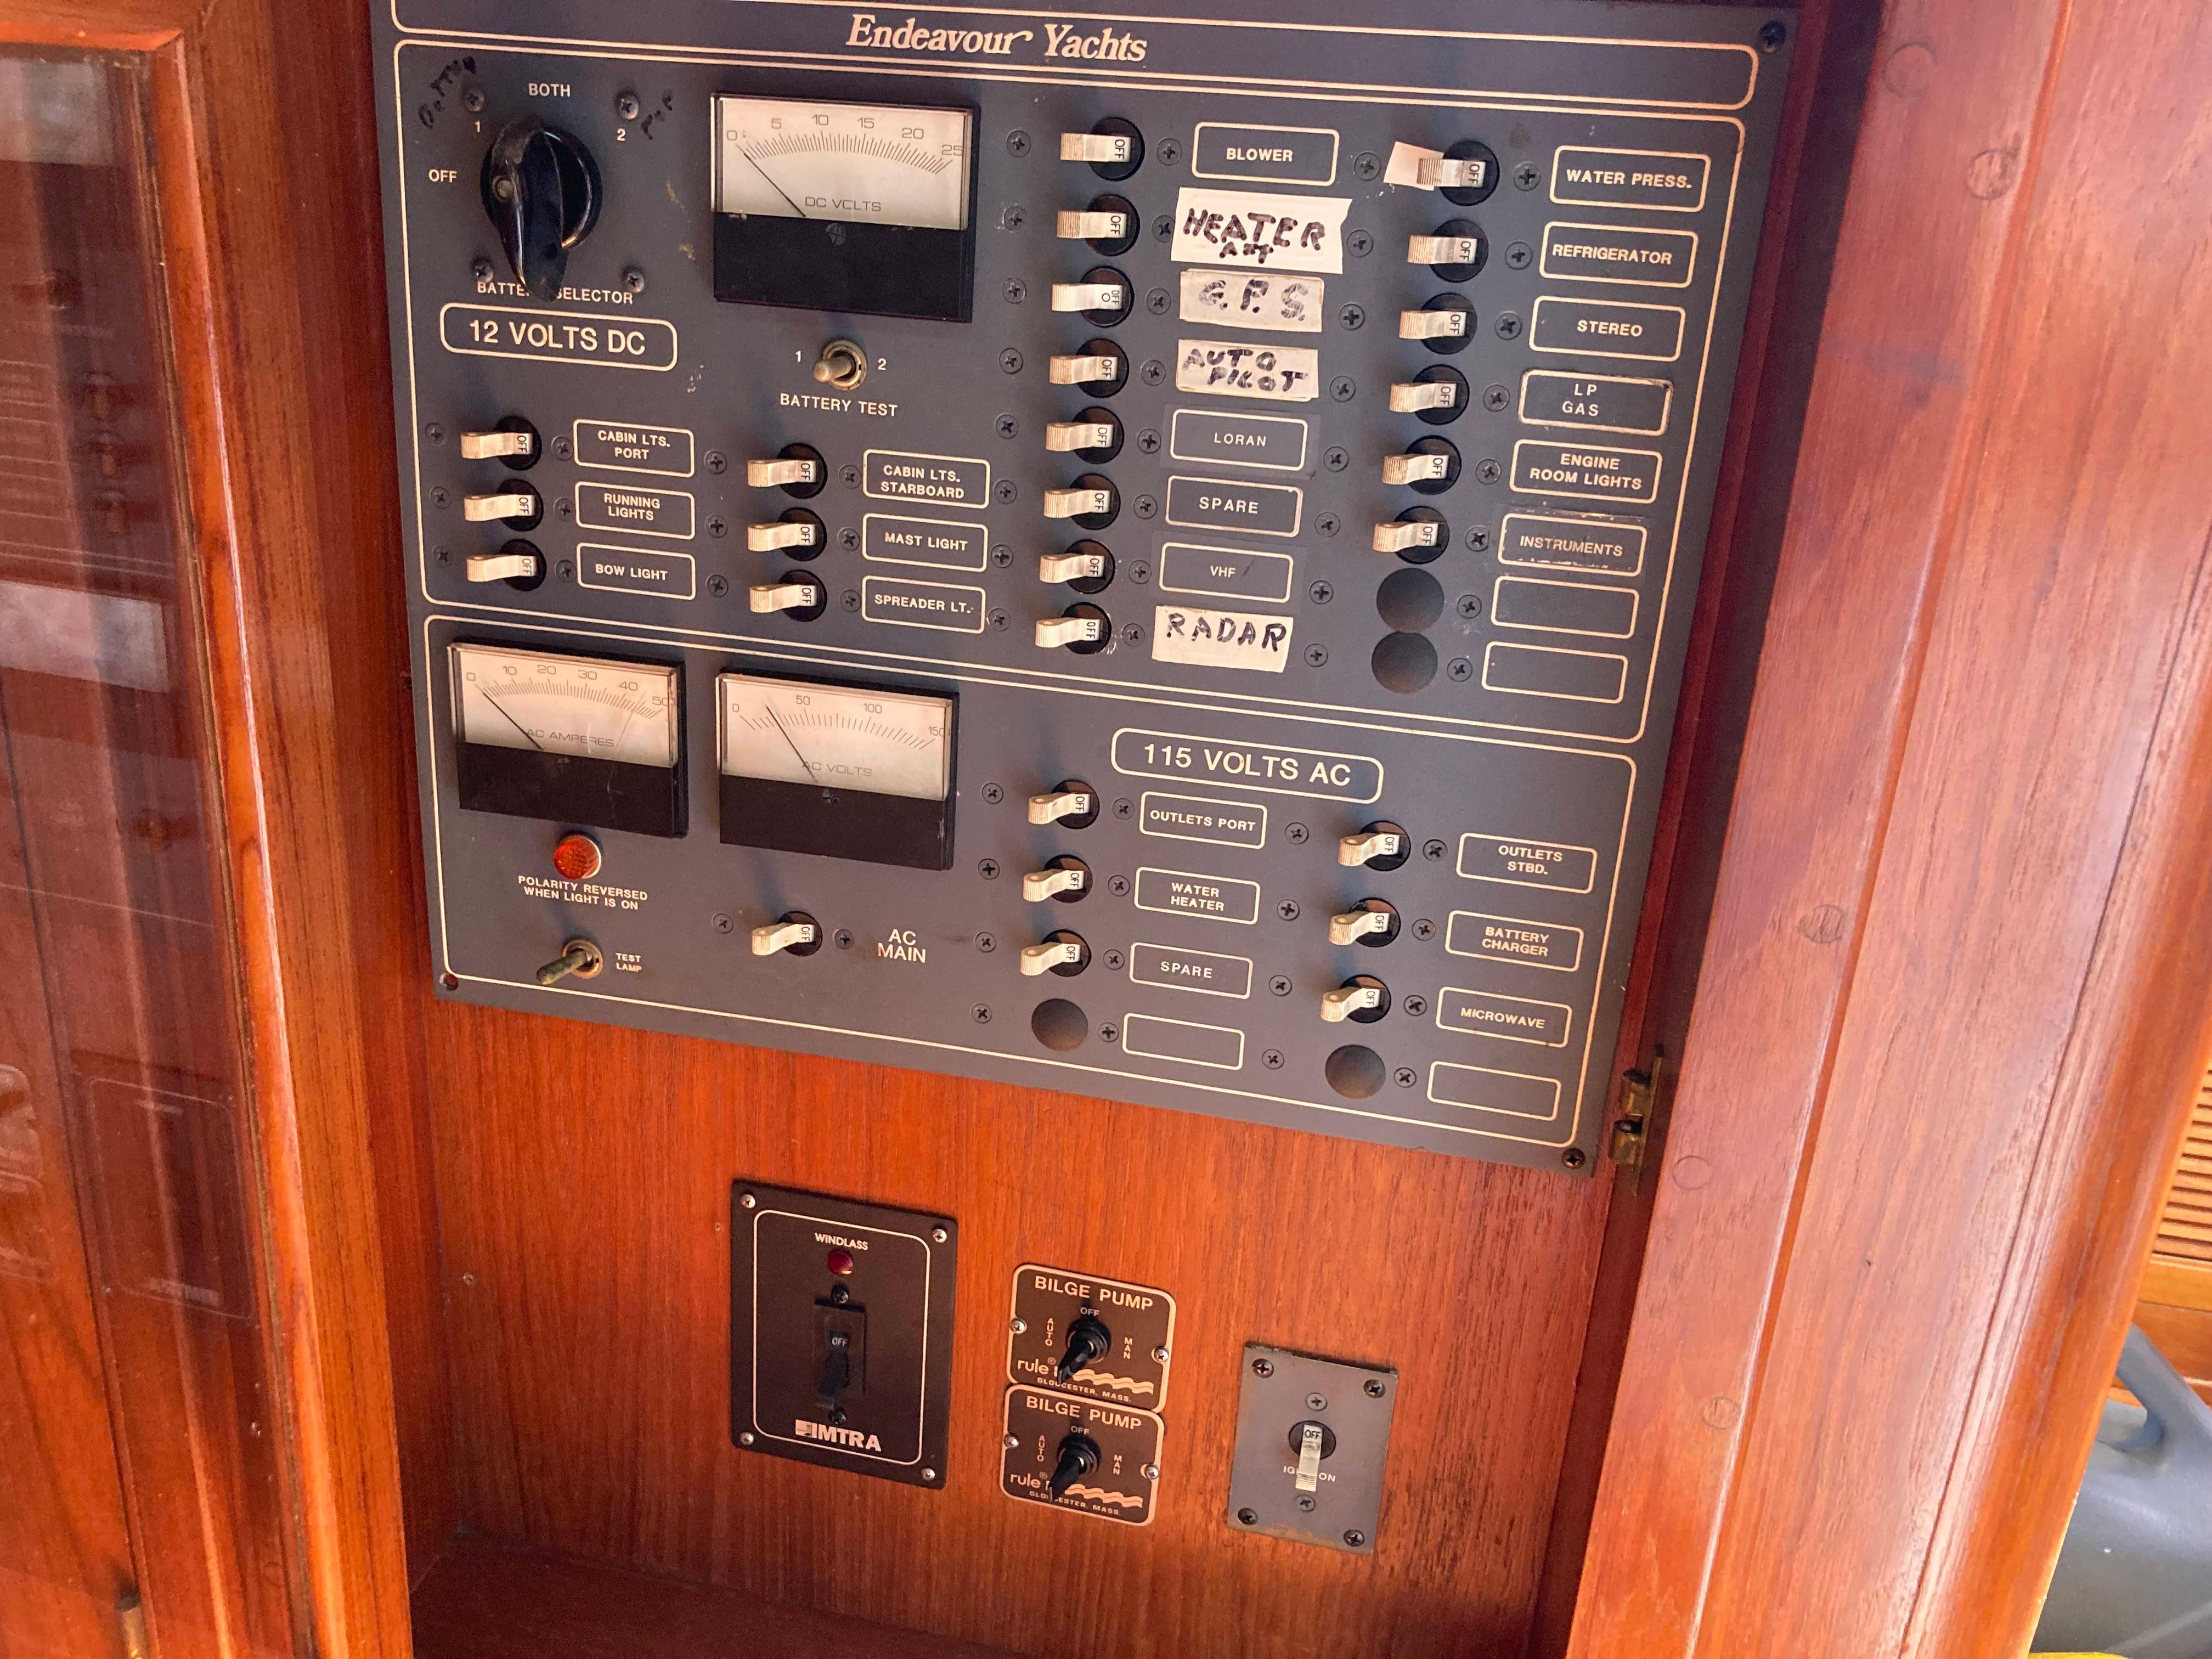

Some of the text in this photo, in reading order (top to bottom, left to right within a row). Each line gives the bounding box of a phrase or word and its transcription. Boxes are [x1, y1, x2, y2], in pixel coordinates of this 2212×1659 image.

[845, 13, 1147, 62] Endeavour Yachts
[528, 83, 571, 97] BOTH
[475, 121, 481, 133] 1
[771, 119, 782, 129] 5
[812, 115, 829, 126] 10
[857, 118, 874, 129] 15
[617, 129, 625, 141] 2
[726, 130, 737, 142] 0
[901, 128, 924, 139] 20
[942, 145, 963, 156] 25
[1114, 138, 1125, 160] OFF
[1226, 148, 1293, 162] BLOWER
[428, 169, 457, 183] OFF
[1469, 163, 1480, 185] OFF
[1566, 169, 1692, 189] WATER PRESS.
[805, 196, 826, 208] DC
[1110, 215, 1121, 236] OFF
[1183, 207, 1326, 251] HEATER
[1460, 240, 1472, 262] OFF
[1552, 244, 1672, 265] REFRIGERATOR
[477, 281, 529, 297] BATTE
[1111, 290, 1120, 307] OFF
[1450, 314, 1461, 335] OFF
[1577, 320, 1643, 337] STEREO
[470, 319, 646, 356] 12 VOLTS DC
[795, 351, 802, 362] 1
[878, 358, 887, 370] 2
[1182, 348, 1277, 372] AUTO
[1101, 359, 1112, 379] OFF
[1440, 386, 1451, 406] OFF
[780, 393, 898, 417] BATTERY TEST
[1562, 400, 1599, 416] GAS
[517, 435, 527, 453] OFF
[598, 430, 671, 448] CABIN LTS.
[1097, 427, 1108, 447] OFF
[1214, 432, 1267, 447] LORAN
[614, 447, 649, 460] PORT
[1560, 453, 1621, 471] ENGINE
[800, 463, 811, 481] OFF
[883, 465, 961, 483] CABIN LTS.
[1432, 458, 1443, 478] OFF
[1530, 468, 1641, 489] ROOM LIGHTS
[881, 482, 964, 499] STARBOARD
[518, 497, 529, 515] OFF
[604, 493, 661, 510] RUNNING
[1094, 493, 1105, 512] OFF
[1199, 496, 1259, 514] SPARE
[608, 505, 654, 521] LIGHTS
[800, 526, 810, 544] OFF
[884, 532, 968, 551] MAST LIGHT
[1423, 526, 1434, 546] OFF
[1520, 535, 1623, 557] INSTRUMENTS
[522, 558, 532, 575] OFF
[595, 563, 668, 581] BOW LIGHT
[1089, 558, 1099, 576] OFF
[1210, 566, 1236, 578] VHF
[802, 588, 811, 605] OFF
[874, 594, 971, 614] SPREADER LT.
[1086, 621, 1096, 640] OFF
[1166, 613, 1286, 652] RADAR
[466, 672, 476, 681] 0
[502, 665, 517, 675] 10
[537, 664, 556, 675] 20
[578, 670, 597, 681] 30
[618, 681, 638, 691] 40
[732, 703, 740, 713] 0
[795, 695, 810, 706] 50
[863, 703, 883, 714] 100
[550, 732, 614, 748] AMPERES
[928, 726, 944, 737] 150
[826, 764, 872, 777] VOLTS
[1144, 743, 1351, 786] 115 VOLTS AC
[1075, 796, 1085, 812] OFF
[1150, 810, 1256, 832] OUTLETS PORT
[1385, 837, 1395, 854] OFF
[1498, 845, 1562, 862] OUTLETS
[1507, 861, 1548, 875] STBD.
[518, 876, 648, 901] POLARITY REVERSED
[1070, 873, 1080, 888] OFF
[524, 886, 638, 910] WHEN LIGHT IS ON
[1171, 882, 1220, 898] WATER
[1171, 895, 1224, 911] HEATER
[1375, 915, 1385, 932] OFF
[801, 926, 810, 941] OFF
[888, 928, 916, 946] AC
[1485, 926, 1549, 944] BATTERY
[878, 943, 927, 963] MAIN
[1066, 946, 1076, 961] OFF
[1482, 939, 1549, 957] CHARGER
[616, 953, 641, 962] TEST
[616, 963, 642, 972] LAMP
[1160, 961, 1212, 979] SPARE
[1366, 991, 1376, 1007] OFF
[1460, 1007, 1545, 1029] MICROWAVE
[815, 1232, 868, 1251] WINDLASS
[1035, 1276, 1153, 1311] BILGE PUMP
[1080, 1307, 1100, 1317] OFF
[1045, 1317, 1054, 1346] AUTO
[832, 1337, 848, 1348] OFF
[1124, 1337, 1133, 1359] MAN
[1018, 1358, 1049, 1375] rule
[1102, 1391, 1132, 1403] MASS.
[1026, 1395, 1142, 1430] BILGE PUMP
[811, 1423, 882, 1452] IMTRA
[1071, 1426, 1090, 1435] OFF
[1305, 1429, 1321, 1440] OFF
[1037, 1435, 1045, 1462] AUTO
[1113, 1454, 1122, 1475] MAN
[1010, 1473, 1041, 1488] rule
